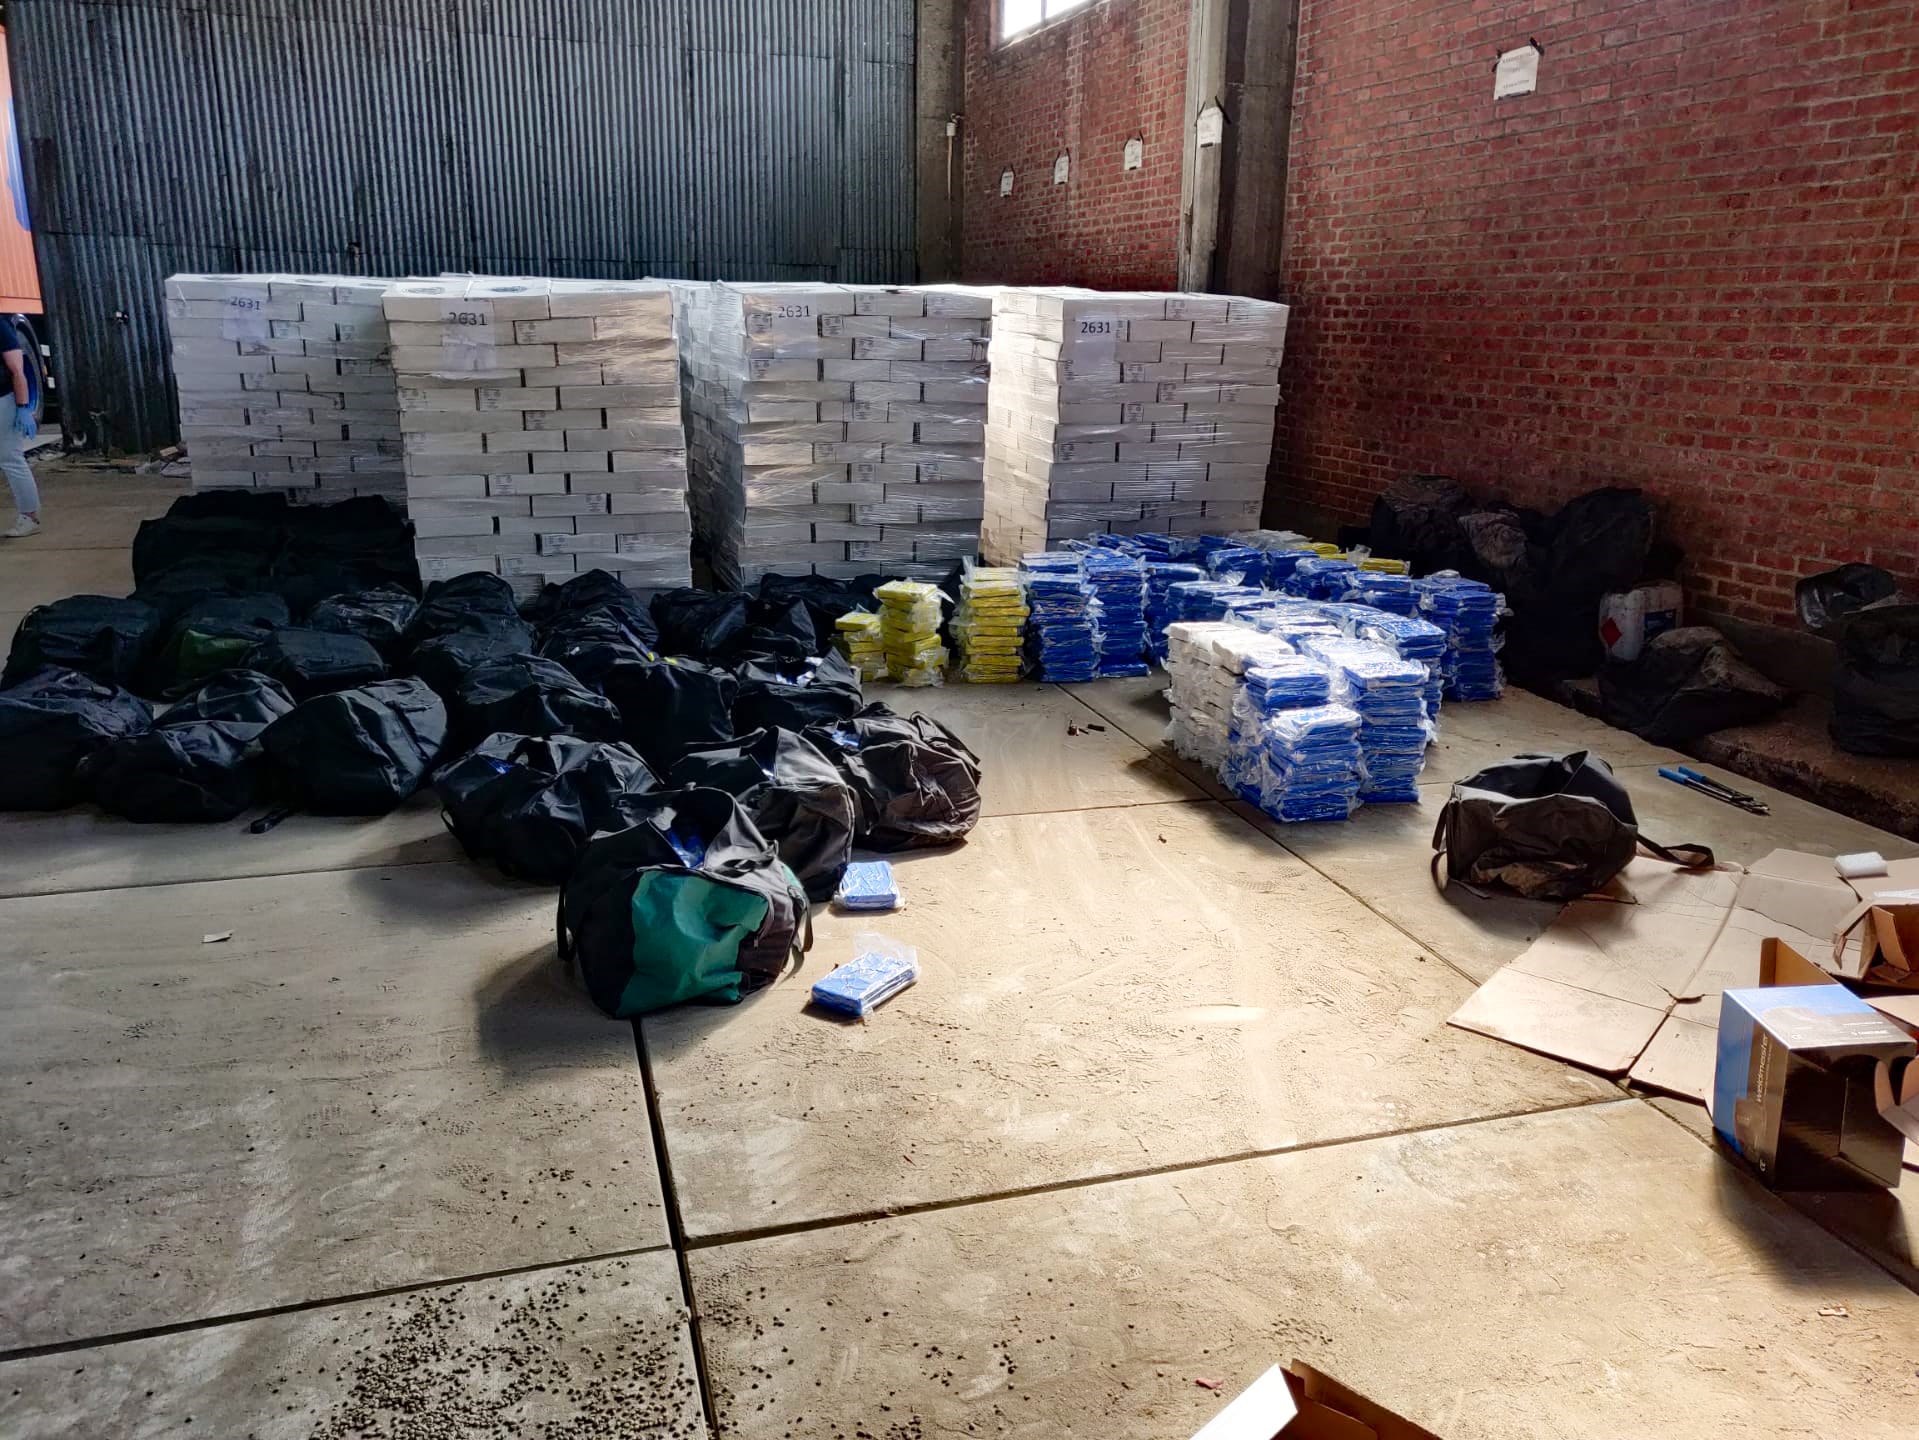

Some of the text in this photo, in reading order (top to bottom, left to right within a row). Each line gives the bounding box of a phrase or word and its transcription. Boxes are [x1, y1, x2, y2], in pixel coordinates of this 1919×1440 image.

[230, 296, 260, 310] 2631
[777, 305, 811, 318] 2631
[450, 312, 488, 325] 2631
[1081, 321, 1111, 333] 2631
